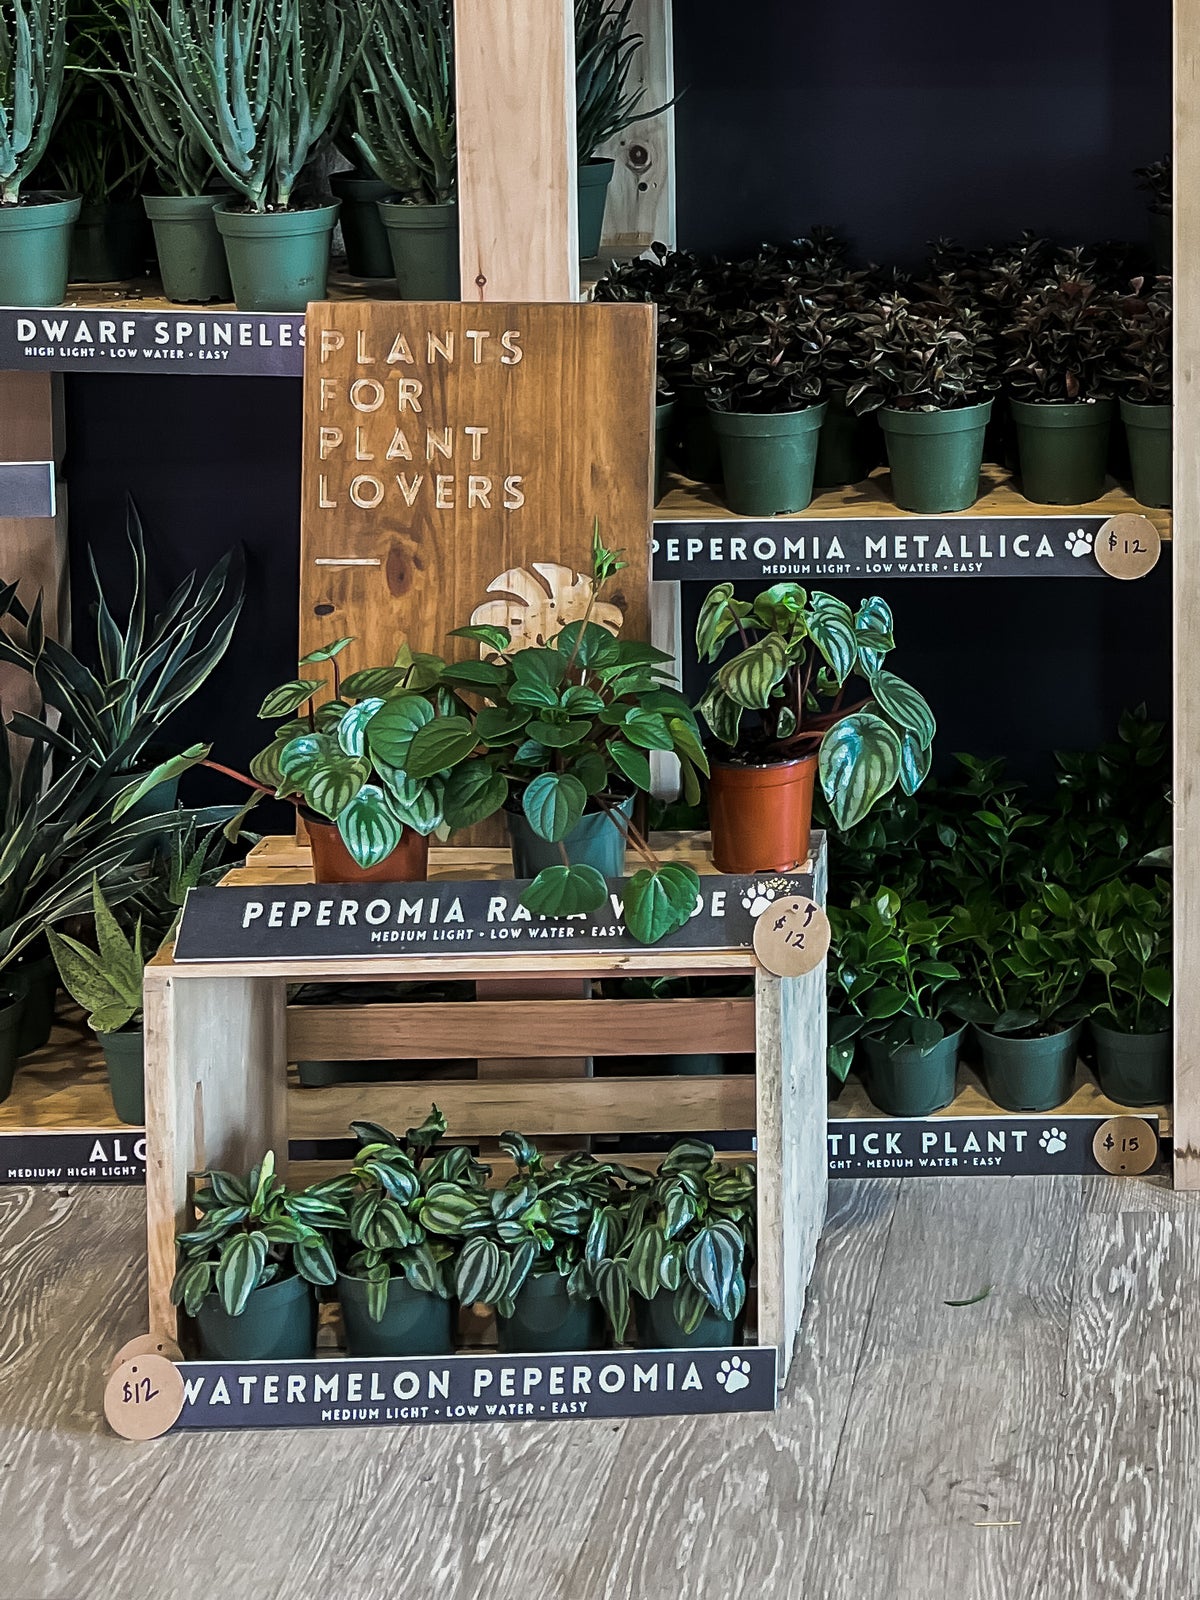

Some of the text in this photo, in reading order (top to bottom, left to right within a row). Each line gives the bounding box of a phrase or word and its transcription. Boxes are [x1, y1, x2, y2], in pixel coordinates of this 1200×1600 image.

[18, 319, 135, 343] DWARF
[24, 346, 229, 360] HIGH LIGHT LOW WATER EASY
[320, 329, 524, 365] PLANTS
[320, 378, 423, 412] FOR
[319, 426, 489, 461] PLANT
[319, 472, 525, 509] LOVERS
[866, 535, 1054, 558] METALLICA
[762, 562, 983, 574] MEDIUM LIGHT LOW WATER EASY
[243, 898, 464, 928] PEPEROMIA
[370, 925, 626, 942] MEDIUM LIGHT LOW WATER EASY
[828, 1131, 1027, 1155] TICK PLANT
[8, 1166, 137, 1178] MEDIUM/ HIGH LIGHT
[866, 1159, 914, 1168] MEDIUM
[918, 1157, 958, 1167] WATER
[973, 1156, 1002, 1166] EASY
[184, 1362, 702, 1406] WATERMELON PEPEROMIA
[321, 1401, 588, 1421] MEDIUM LIGHT LOW WATER EASY
